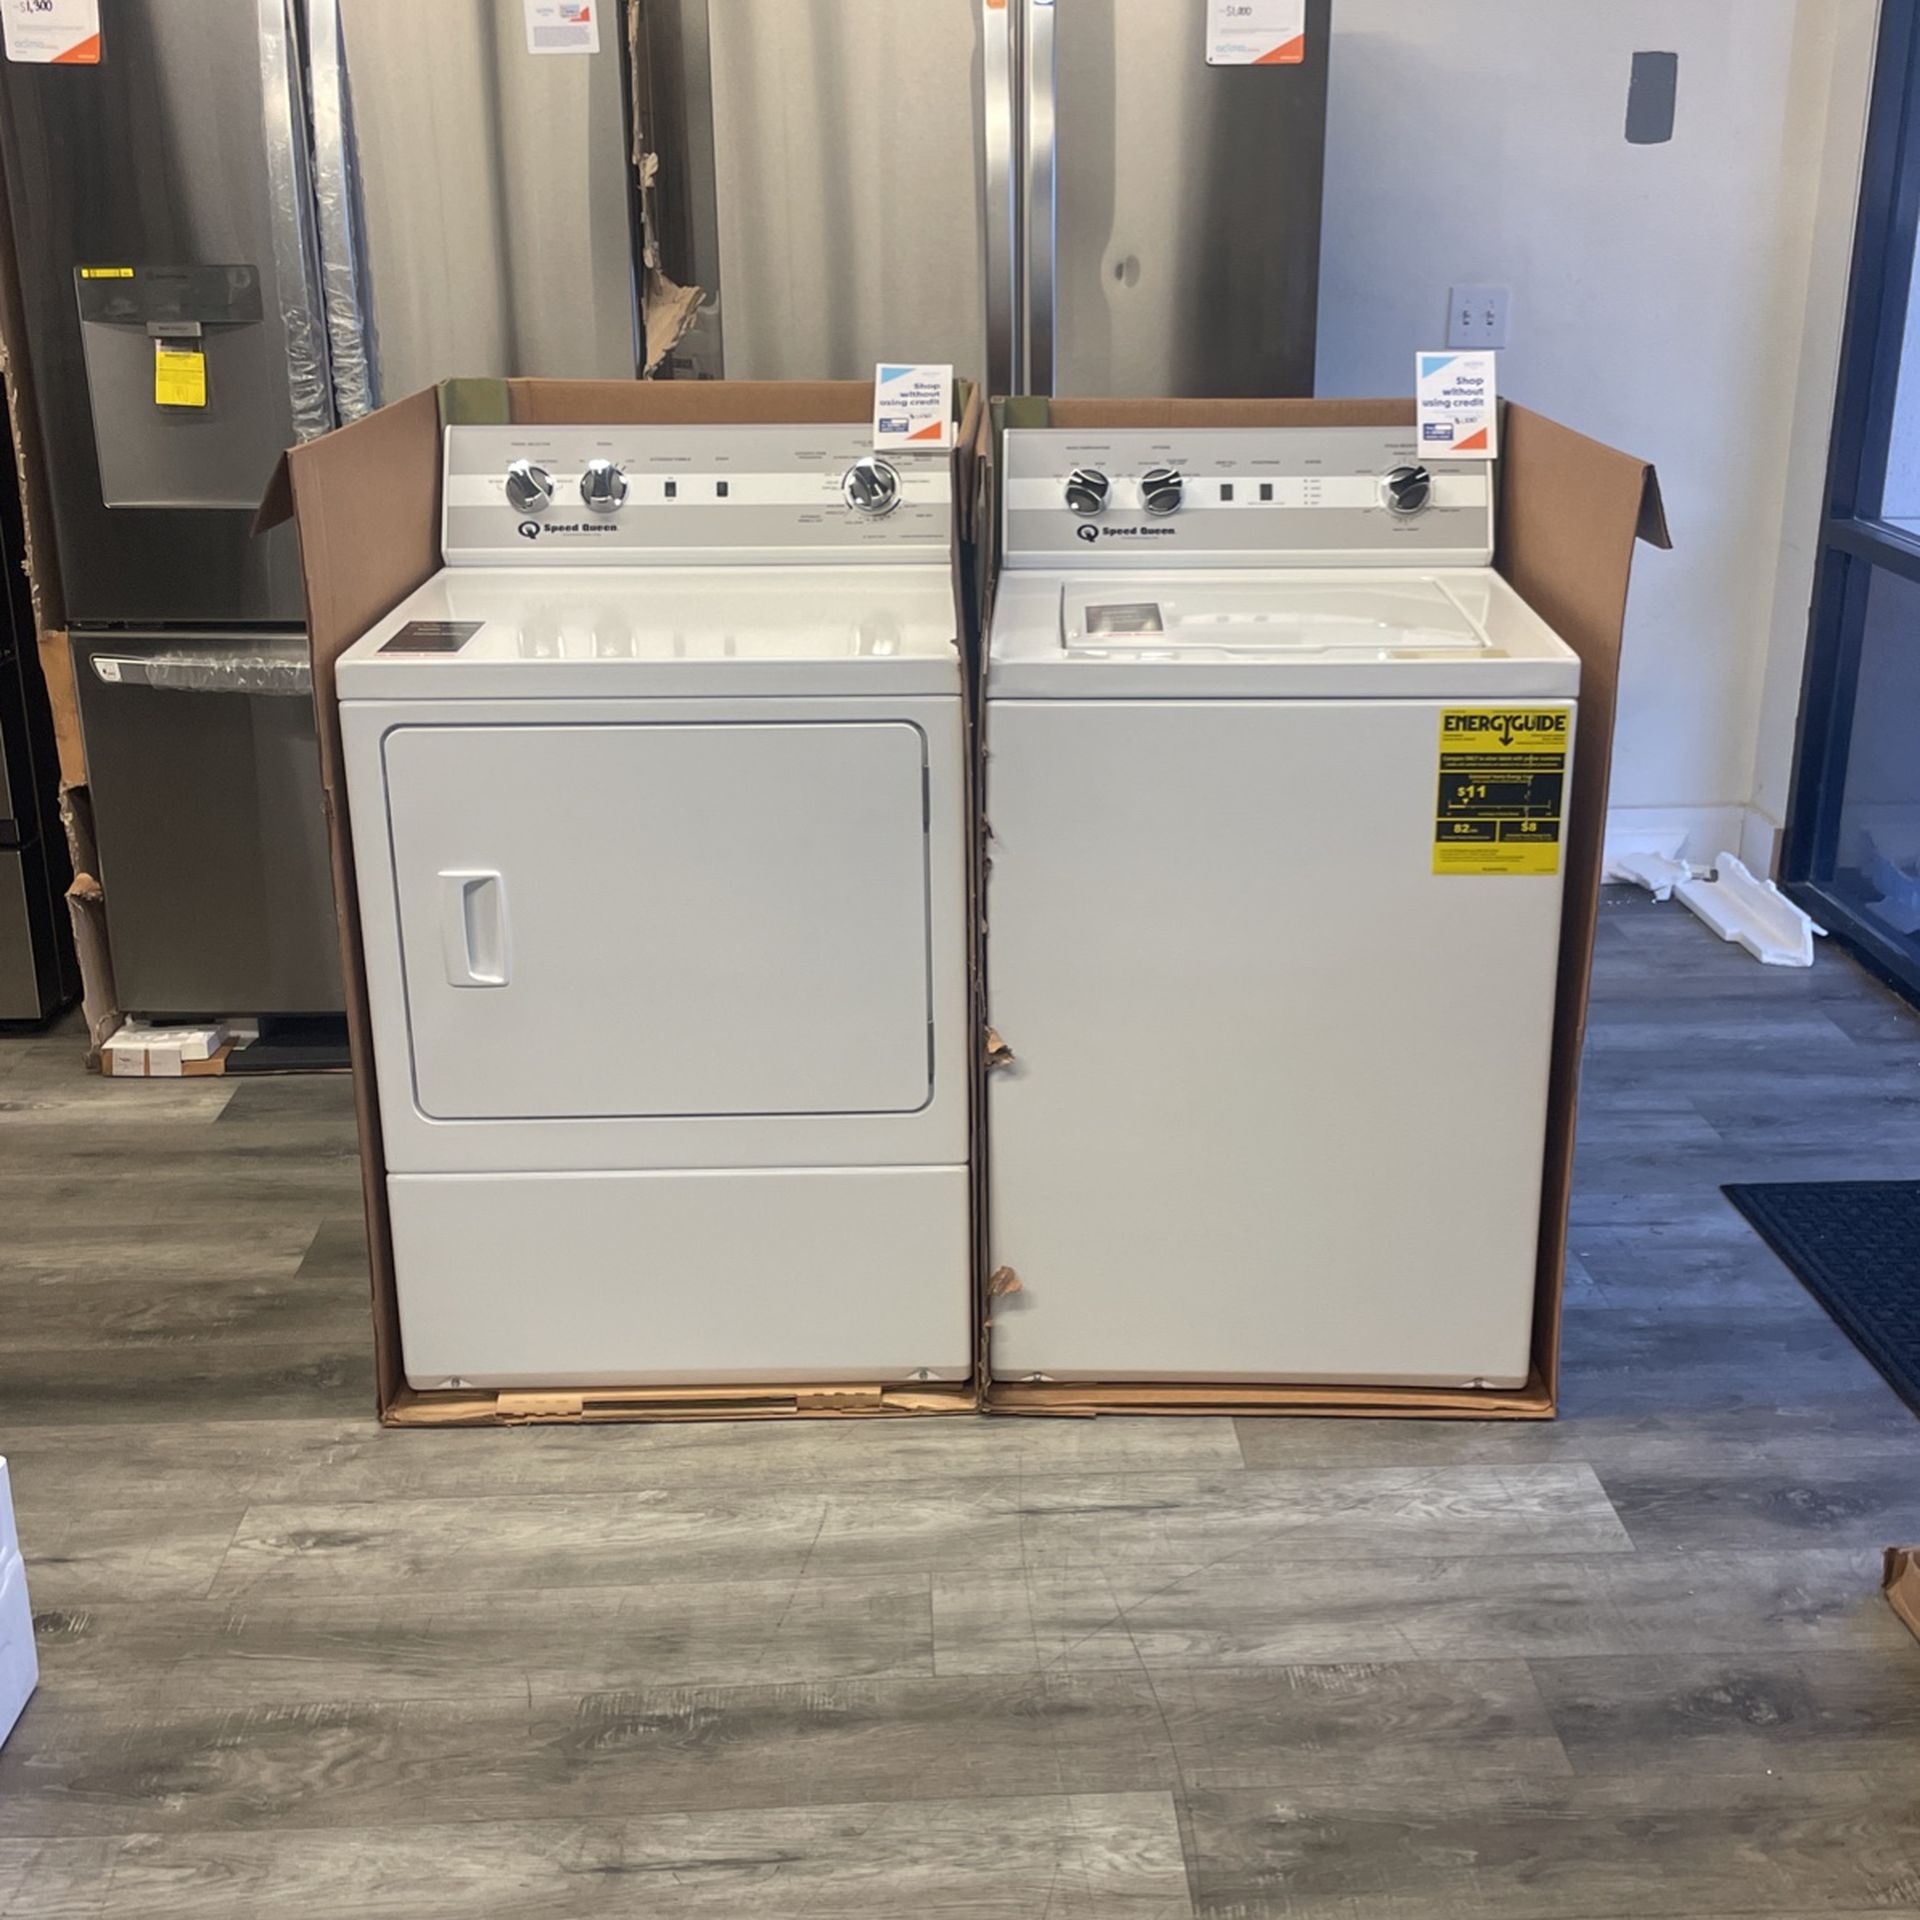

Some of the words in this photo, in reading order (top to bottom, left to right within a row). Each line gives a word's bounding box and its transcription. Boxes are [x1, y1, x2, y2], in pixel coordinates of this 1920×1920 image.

[1456, 376, 1484, 386] Shop
[1442, 388, 1484, 396] without
[880, 399, 908, 407] using
[1422, 399, 1451, 408] using
[1453, 398, 1484, 407] credit
[543, 523, 580, 534] Speed
[581, 523, 618, 533] Queen
[1101, 525, 1138, 537] Speed
[1139, 526, 1177, 536] Queen
[1457, 785, 1487, 799] $11
[1453, 824, 1470, 833] 82
[1521, 822, 1537, 832] $8
